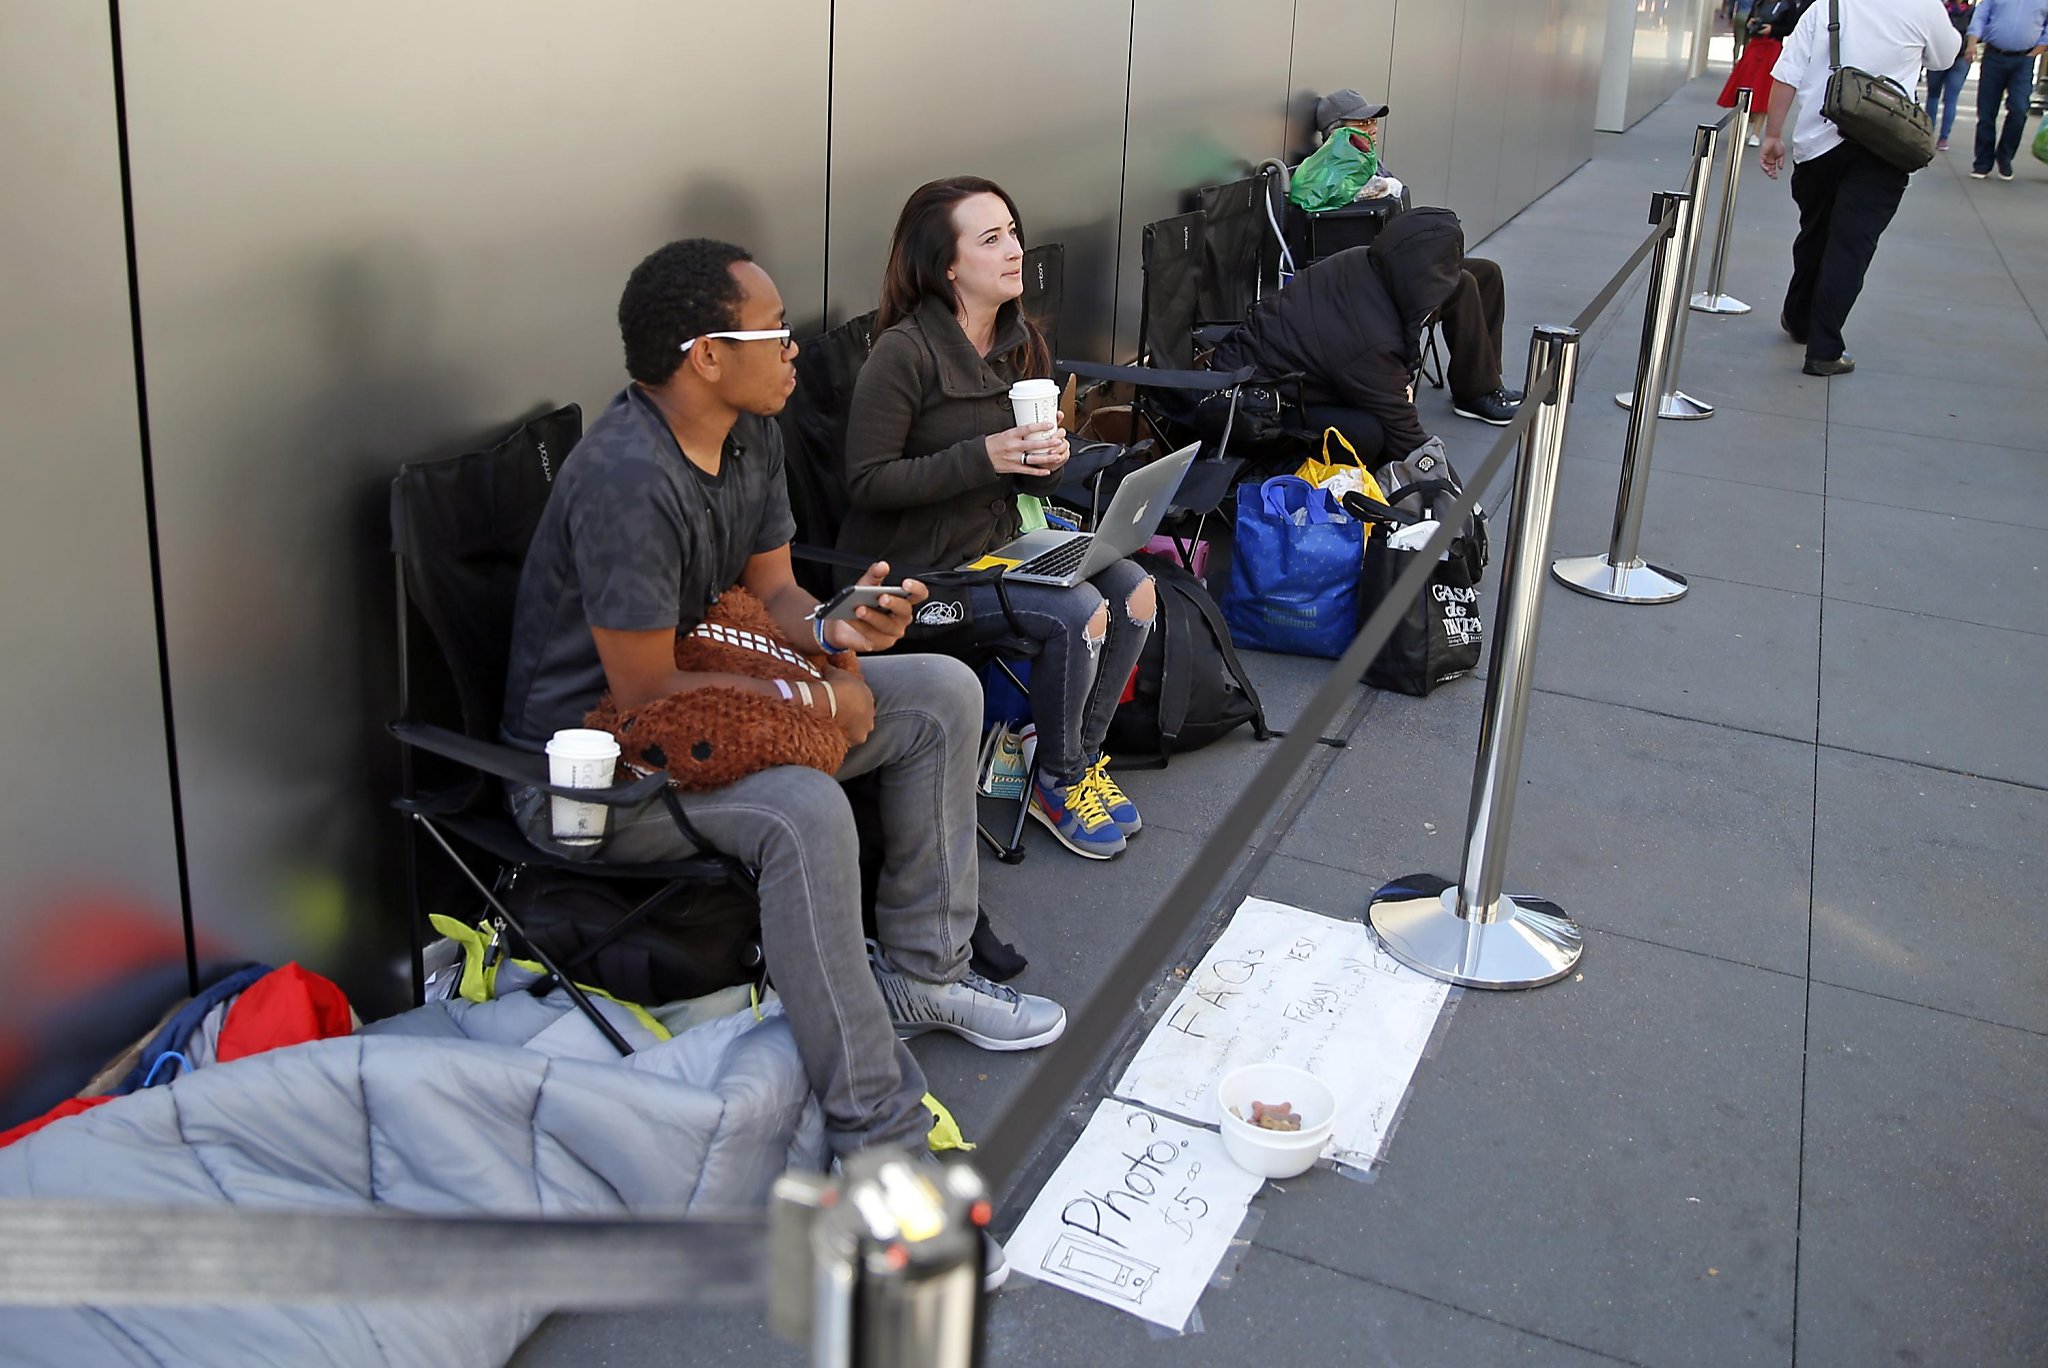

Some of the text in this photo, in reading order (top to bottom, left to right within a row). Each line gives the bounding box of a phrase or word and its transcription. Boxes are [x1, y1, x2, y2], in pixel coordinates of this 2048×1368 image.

[1432, 584, 1477, 603] CASA
[1444, 601, 1467, 617] de
[1284, 937, 1320, 962] YES!
[1167, 949, 1265, 1038] FAQs
[1283, 982, 1339, 1024] Friday!
[1061, 1112, 1189, 1249] Photo?
